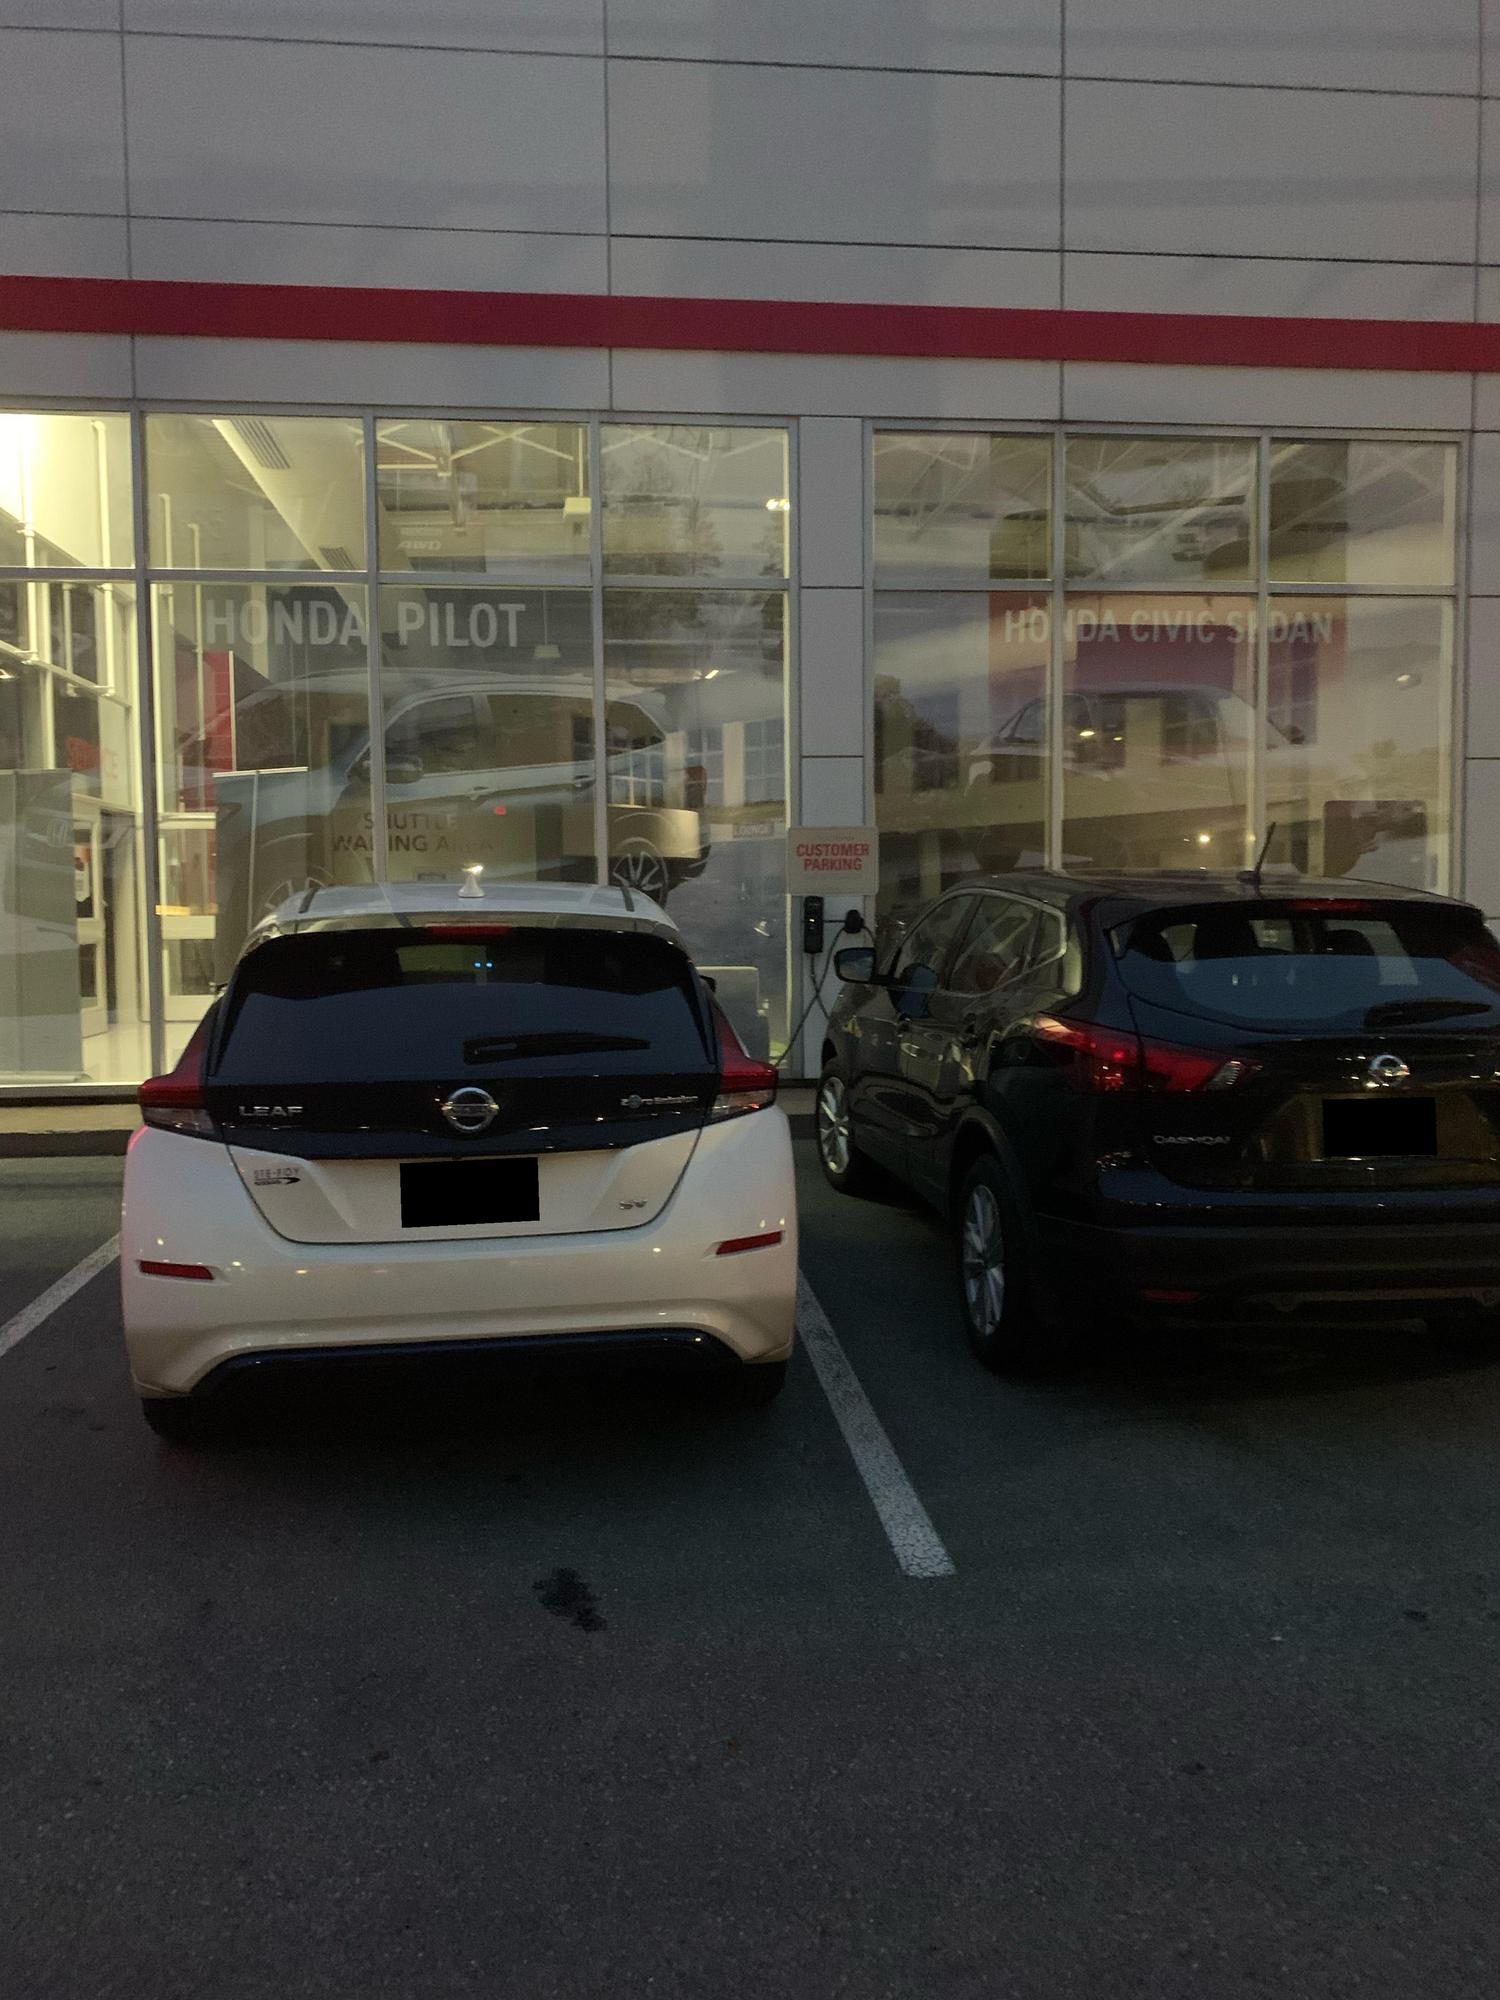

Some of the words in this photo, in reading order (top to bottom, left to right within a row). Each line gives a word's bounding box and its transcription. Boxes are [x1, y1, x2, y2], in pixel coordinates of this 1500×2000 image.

[205, 599, 371, 646] HONDA
[396, 602, 526, 648] PILOT
[1004, 609, 1120, 643] HONDA
[1130, 610, 1217, 644] CIVIC
[796, 843, 870, 857] CUSTOMER
[804, 858, 862, 871] PARKING
[239, 1105, 304, 1117] LEAF
